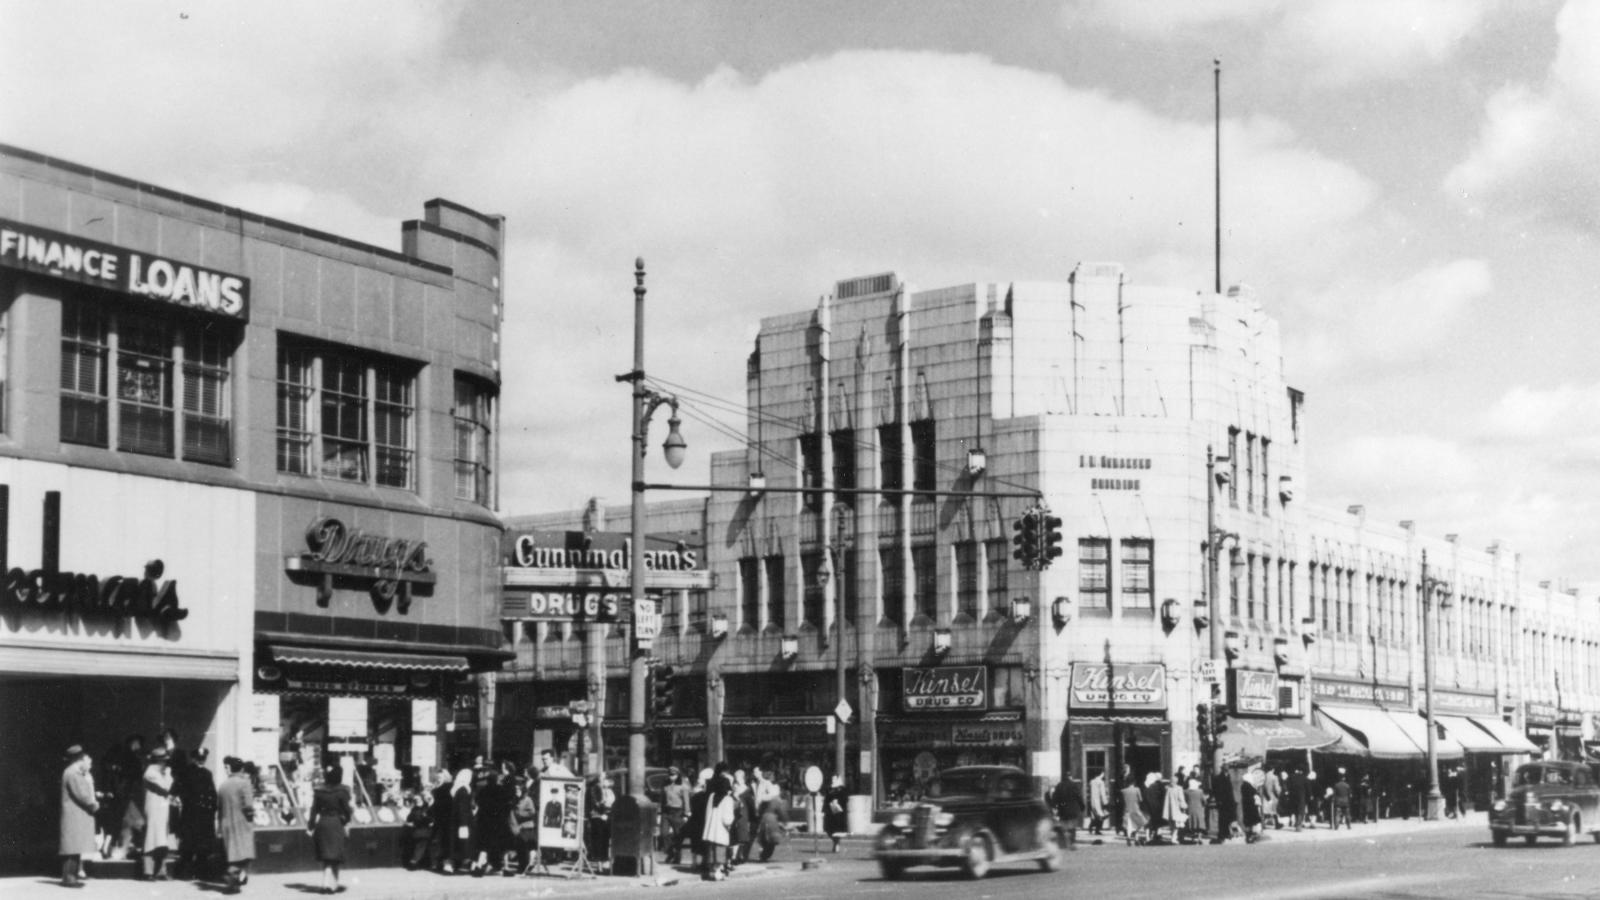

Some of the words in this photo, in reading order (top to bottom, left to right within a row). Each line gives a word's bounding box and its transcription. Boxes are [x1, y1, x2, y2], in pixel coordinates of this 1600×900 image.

[1, 228, 118, 280] FINANCE
[129, 253, 243, 315] LOANS
[301, 517, 434, 600] Drugs
[531, 592, 618, 615] DRUGS
[906, 667, 981, 694] Kinsel
[1074, 666, 1161, 690] Kinsel
[915, 696, 949, 706] DRUG
